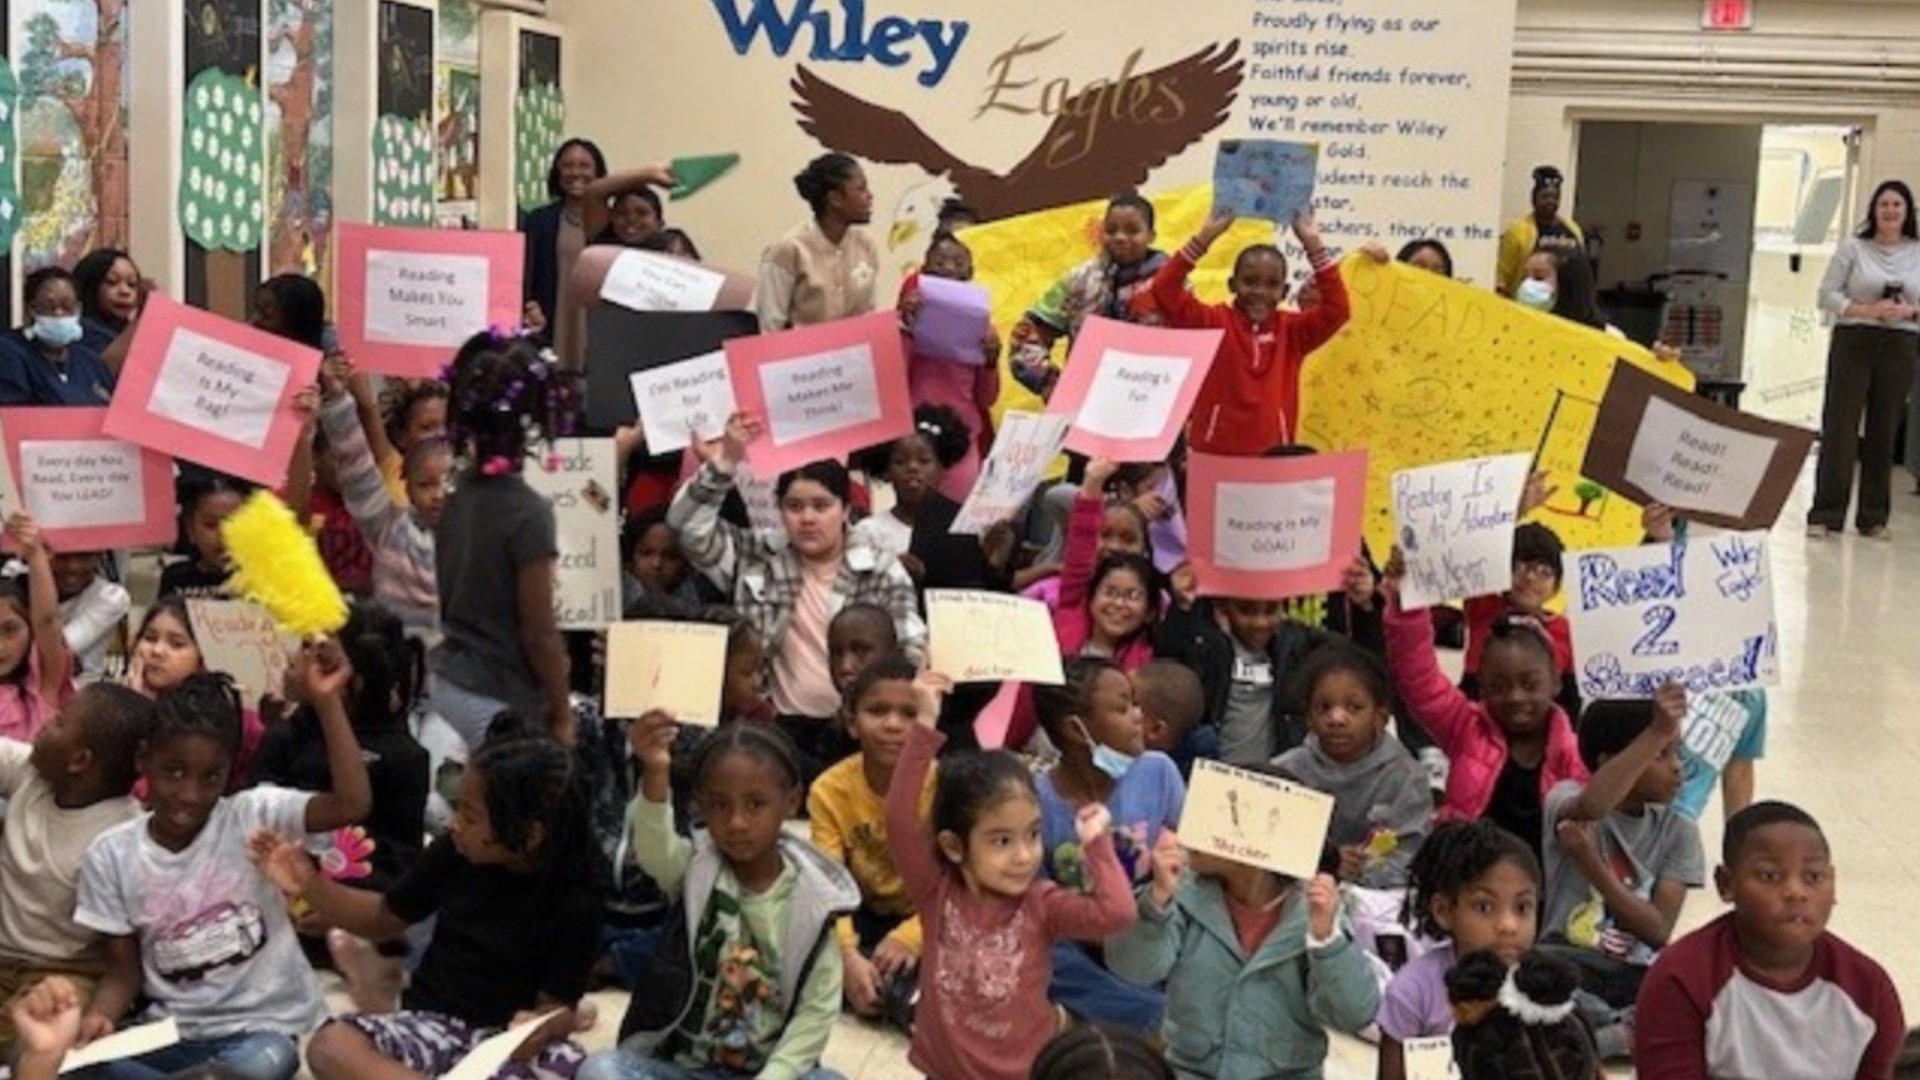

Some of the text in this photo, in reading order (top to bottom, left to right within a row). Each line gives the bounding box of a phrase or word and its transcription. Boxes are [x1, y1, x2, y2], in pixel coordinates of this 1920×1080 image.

[1252, 12, 1440, 33] Proudly flying as our
[715, 0, 971, 89] Wiley
[1252, 41, 1307, 58] spirits
[1250, 64, 1471, 88] Faithful friends forever,
[971, 31, 1189, 169] Eagles
[1249, 94, 1298, 110] young
[1305, 95, 1323, 107] or
[1249, 117, 1447, 139] We'll remember Wiley
[1382, 172, 1432, 189] reach
[1440, 171, 1470, 189] the
[1389, 221, 1455, 240] they're
[1463, 222, 1493, 239] the
[399, 267, 456, 285] Reading
[389, 288, 464, 306] Makes You
[404, 313, 446, 328] Smart
[196, 352, 256, 384] Reading
[673, 367, 726, 388] Reading
[791, 365, 843, 384] Reading
[1116, 367, 1161, 386] Reading
[214, 378, 240, 400] My
[787, 382, 853, 403] Makes Me
[1128, 389, 1149, 402] Fun
[1678, 430, 1728, 454] Read!
[37, 455, 72, 468] Every
[74, 453, 96, 467] day
[1671, 451, 1720, 475] Read!
[70, 472, 104, 484] Every
[107, 471, 131, 484] day
[1462, 461, 1494, 499] Is
[1662, 472, 1711, 494] Read!
[51, 490, 72, 501] You
[1227, 518, 1283, 533] Reading
[1300, 515, 1319, 530] My
[1578, 543, 1686, 611] Read
[1632, 604, 1679, 655] 2
